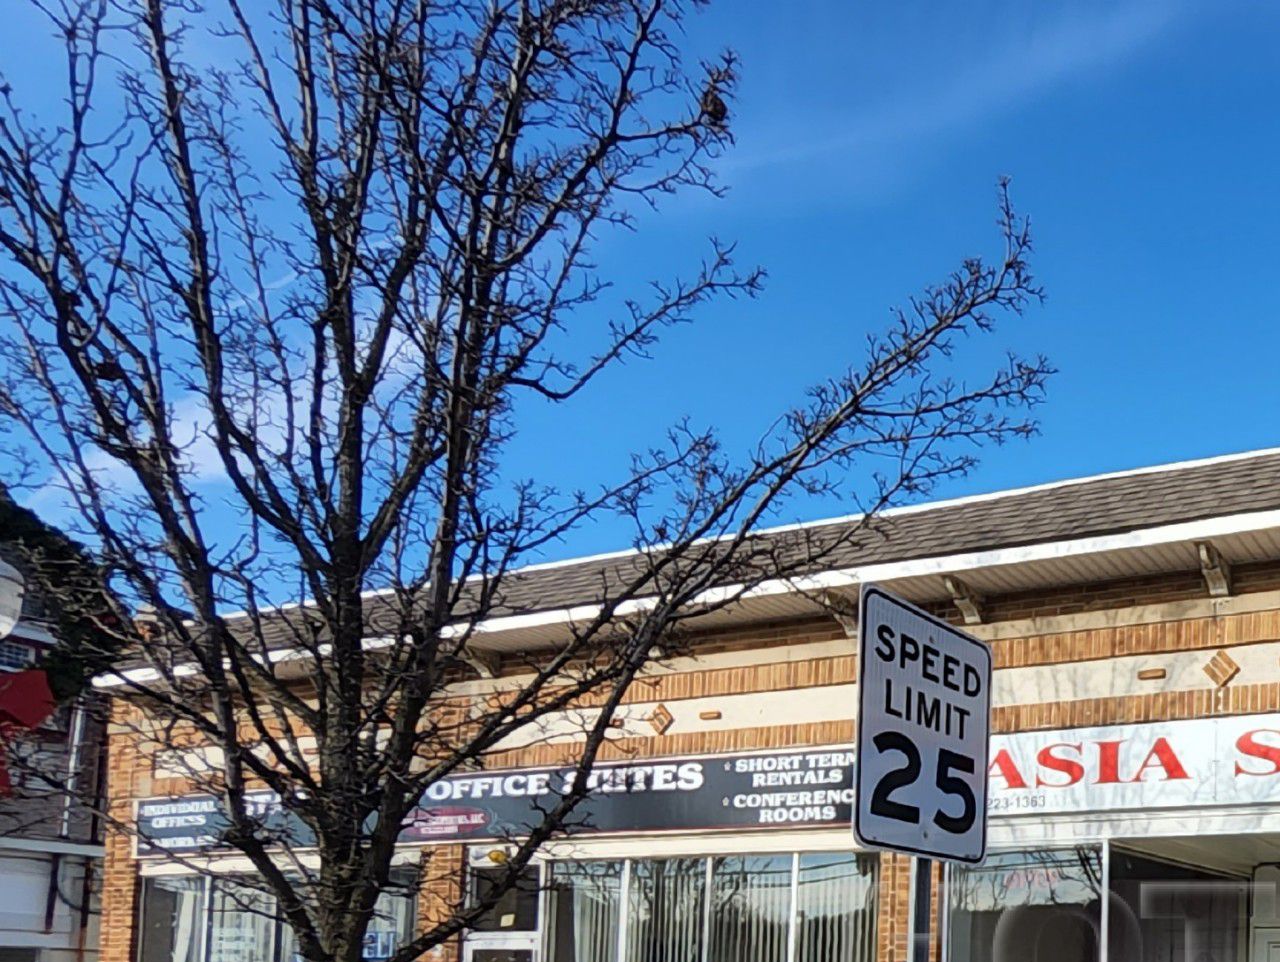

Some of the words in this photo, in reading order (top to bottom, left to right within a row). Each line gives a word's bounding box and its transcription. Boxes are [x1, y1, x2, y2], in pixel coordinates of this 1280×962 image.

[875, 624, 981, 698] SPEED
[885, 678, 970, 740] LIMIT
[735, 753, 803, 773] SHORT
[988, 737, 1193, 789] ASIA
[425, 773, 550, 801] OFFICE
[752, 769, 843, 788] RENTALS
[870, 731, 976, 834] 25
[733, 788, 854, 809] CONFERENC
[758, 805, 837, 823] ROOMS
